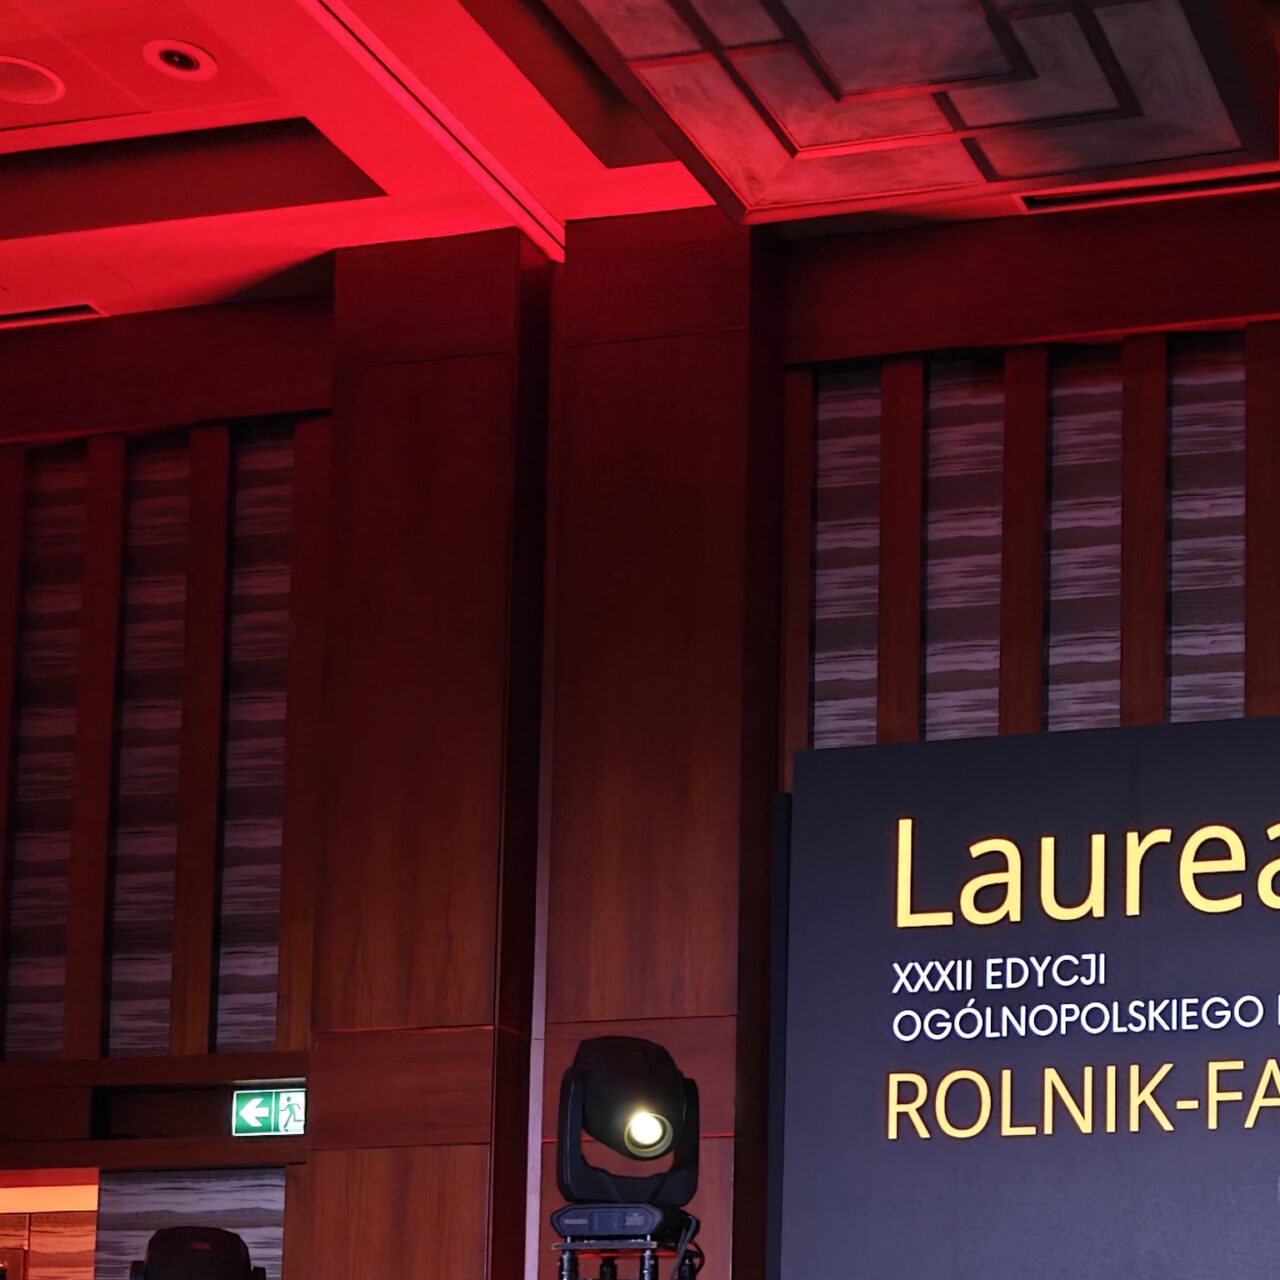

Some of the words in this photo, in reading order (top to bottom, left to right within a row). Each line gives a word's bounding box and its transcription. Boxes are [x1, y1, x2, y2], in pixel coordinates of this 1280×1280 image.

[892, 959, 972, 994] XXXII
[985, 953, 1106, 990] EDYCJI
[892, 996, 1264, 1042] OGÓLNOPOLSKIEGO
